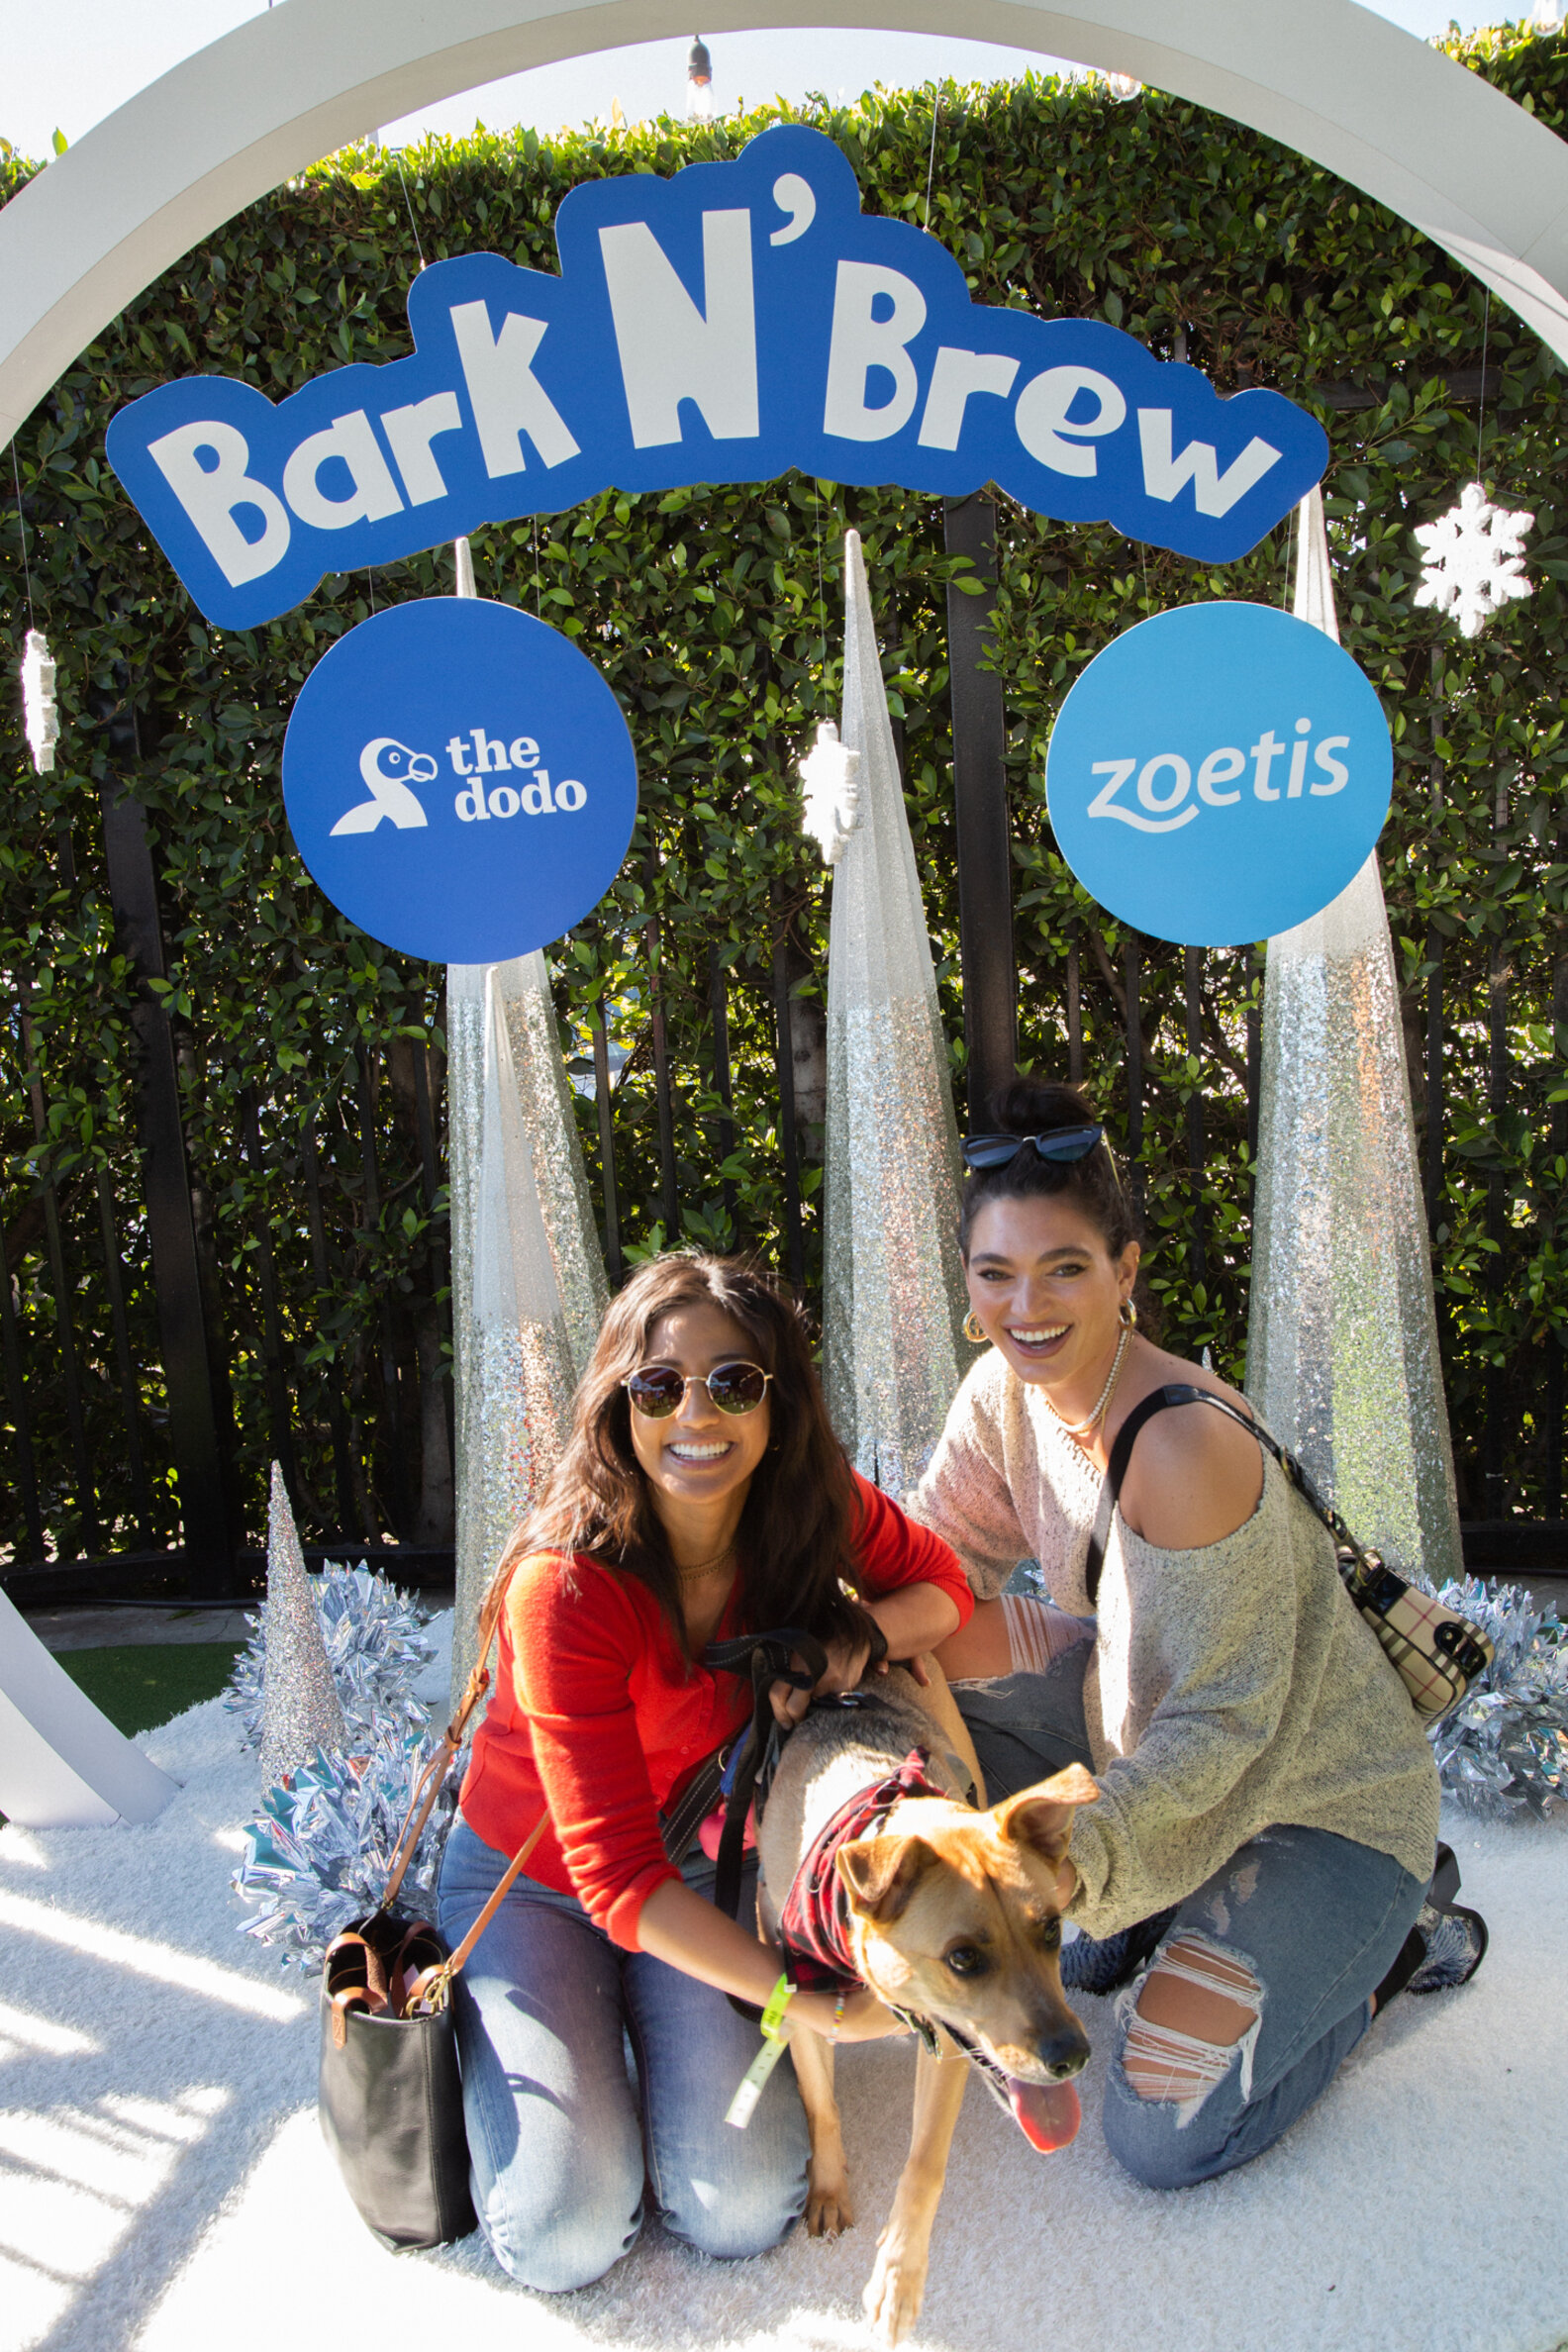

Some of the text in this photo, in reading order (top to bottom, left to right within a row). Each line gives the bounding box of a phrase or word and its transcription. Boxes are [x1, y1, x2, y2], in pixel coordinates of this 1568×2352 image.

[147, 300, 581, 588] Bark
[824, 259, 1283, 518] Brew
[445, 729, 540, 774] the
[1086, 718, 1350, 833] zoetis
[454, 770, 587, 822] dodo
